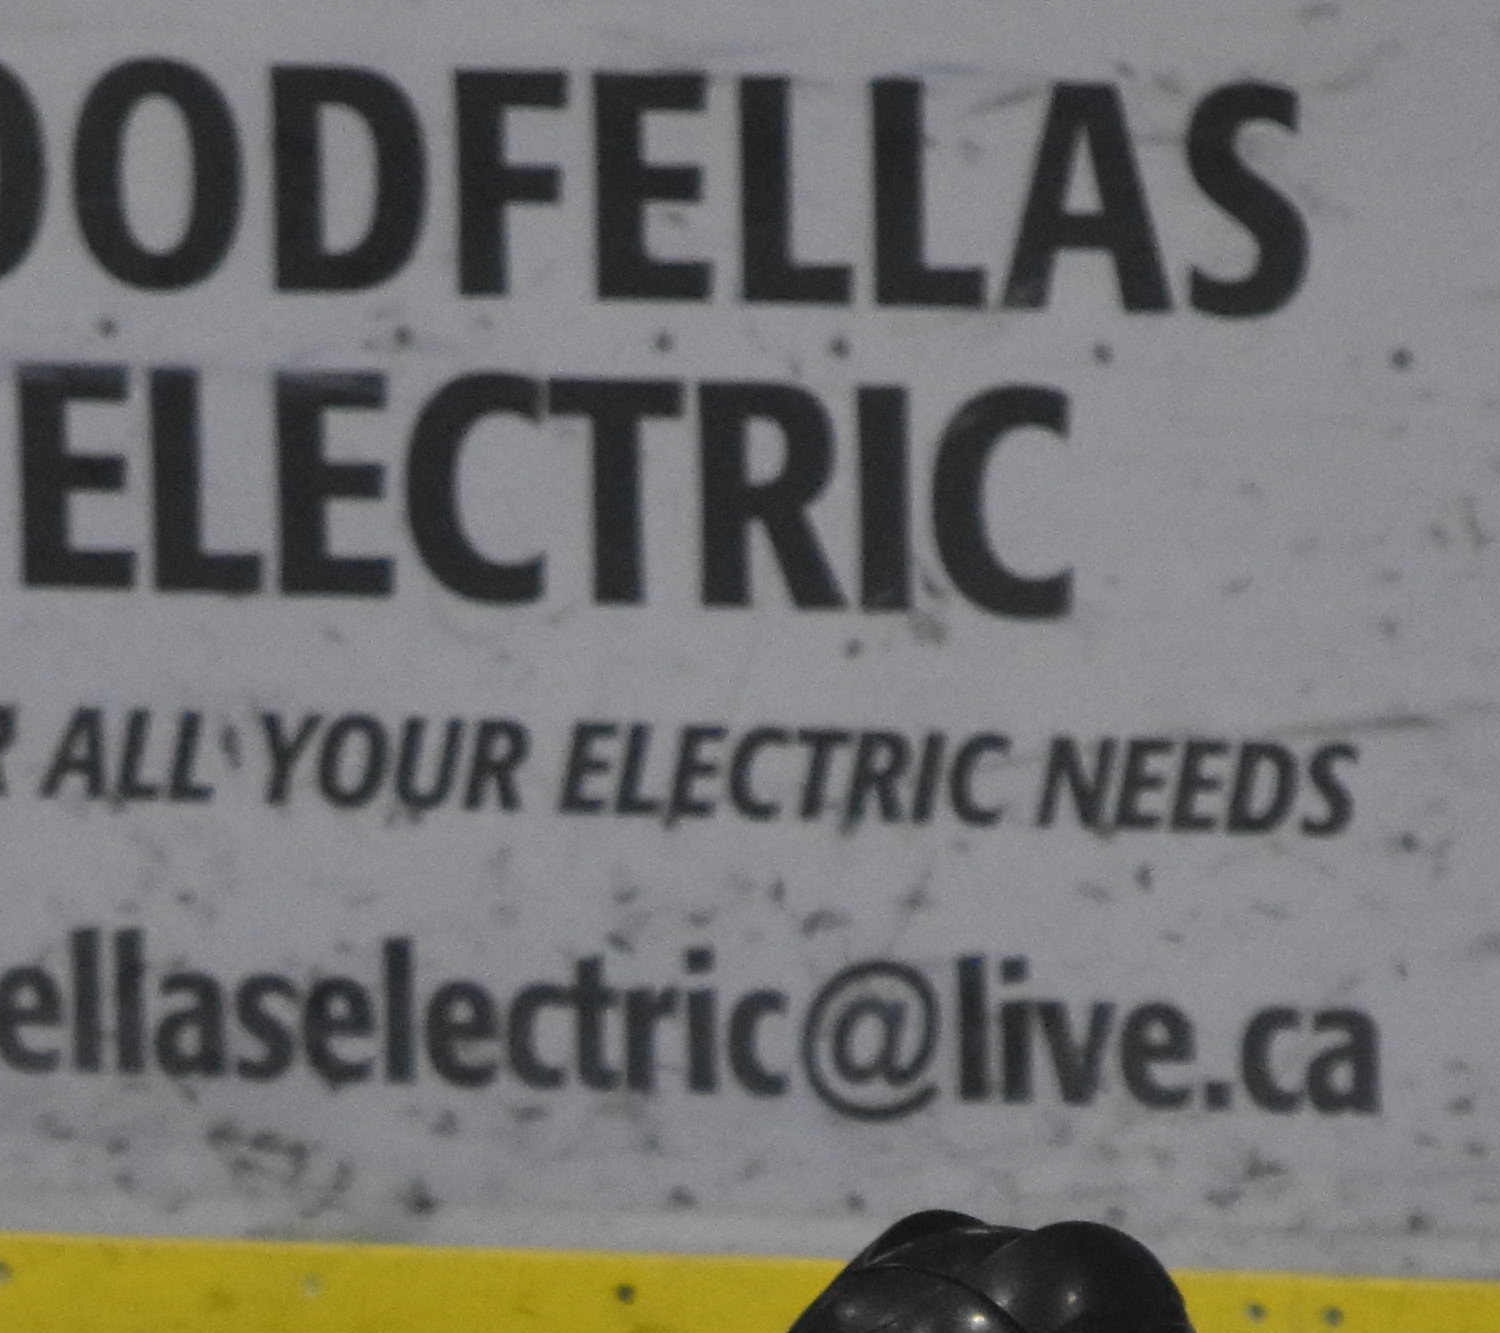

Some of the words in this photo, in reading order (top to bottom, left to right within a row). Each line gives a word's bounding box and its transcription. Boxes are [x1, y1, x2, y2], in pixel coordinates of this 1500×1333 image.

[14, 362, 1076, 621] ELECTRIC
[41, 706, 216, 804] ALL
[259, 713, 530, 814] YOUR
[556, 720, 1010, 832] ELECTRIC
[1035, 736, 1362, 838] NEEDS
